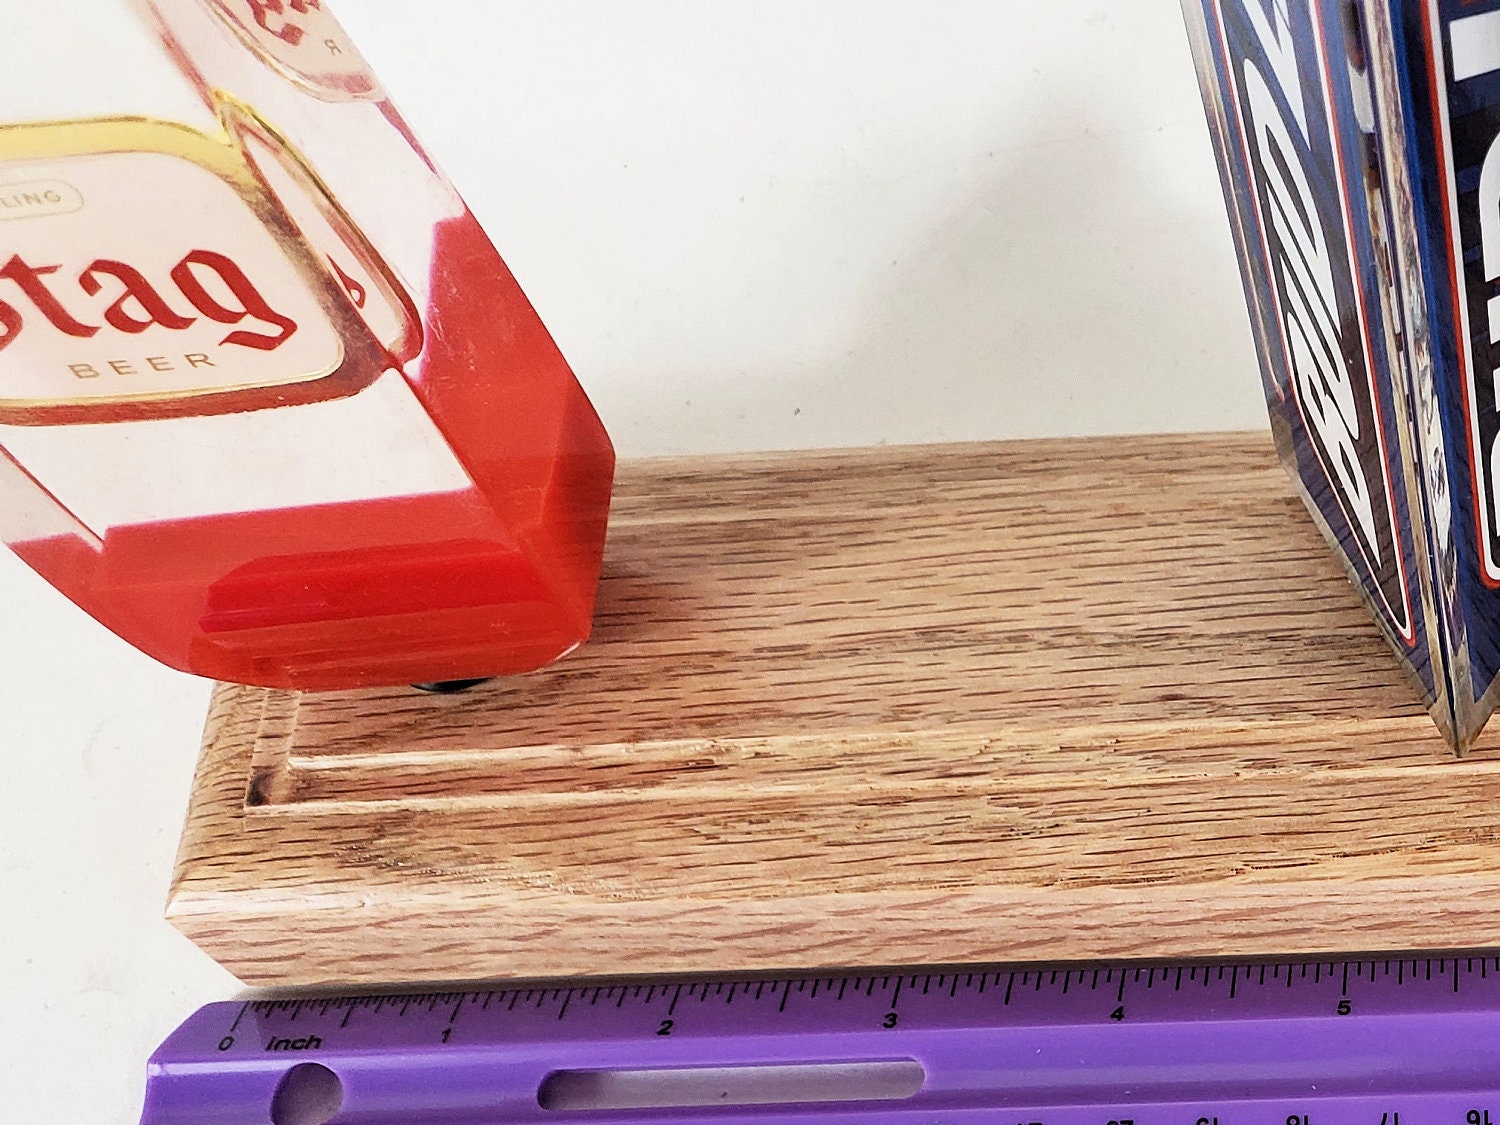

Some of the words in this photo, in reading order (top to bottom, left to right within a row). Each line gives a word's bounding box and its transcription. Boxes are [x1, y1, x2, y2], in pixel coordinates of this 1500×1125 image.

[67, 352, 216, 380] BEER
[217, 1035, 236, 1052] 0
[264, 1034, 323, 1052] inch
[440, 1027, 452, 1044] 1
[655, 1019, 675, 1036] 2
[882, 1012, 899, 1029] 3
[1109, 1005, 1125, 1022] 4
[1336, 999, 1352, 1016] 5
